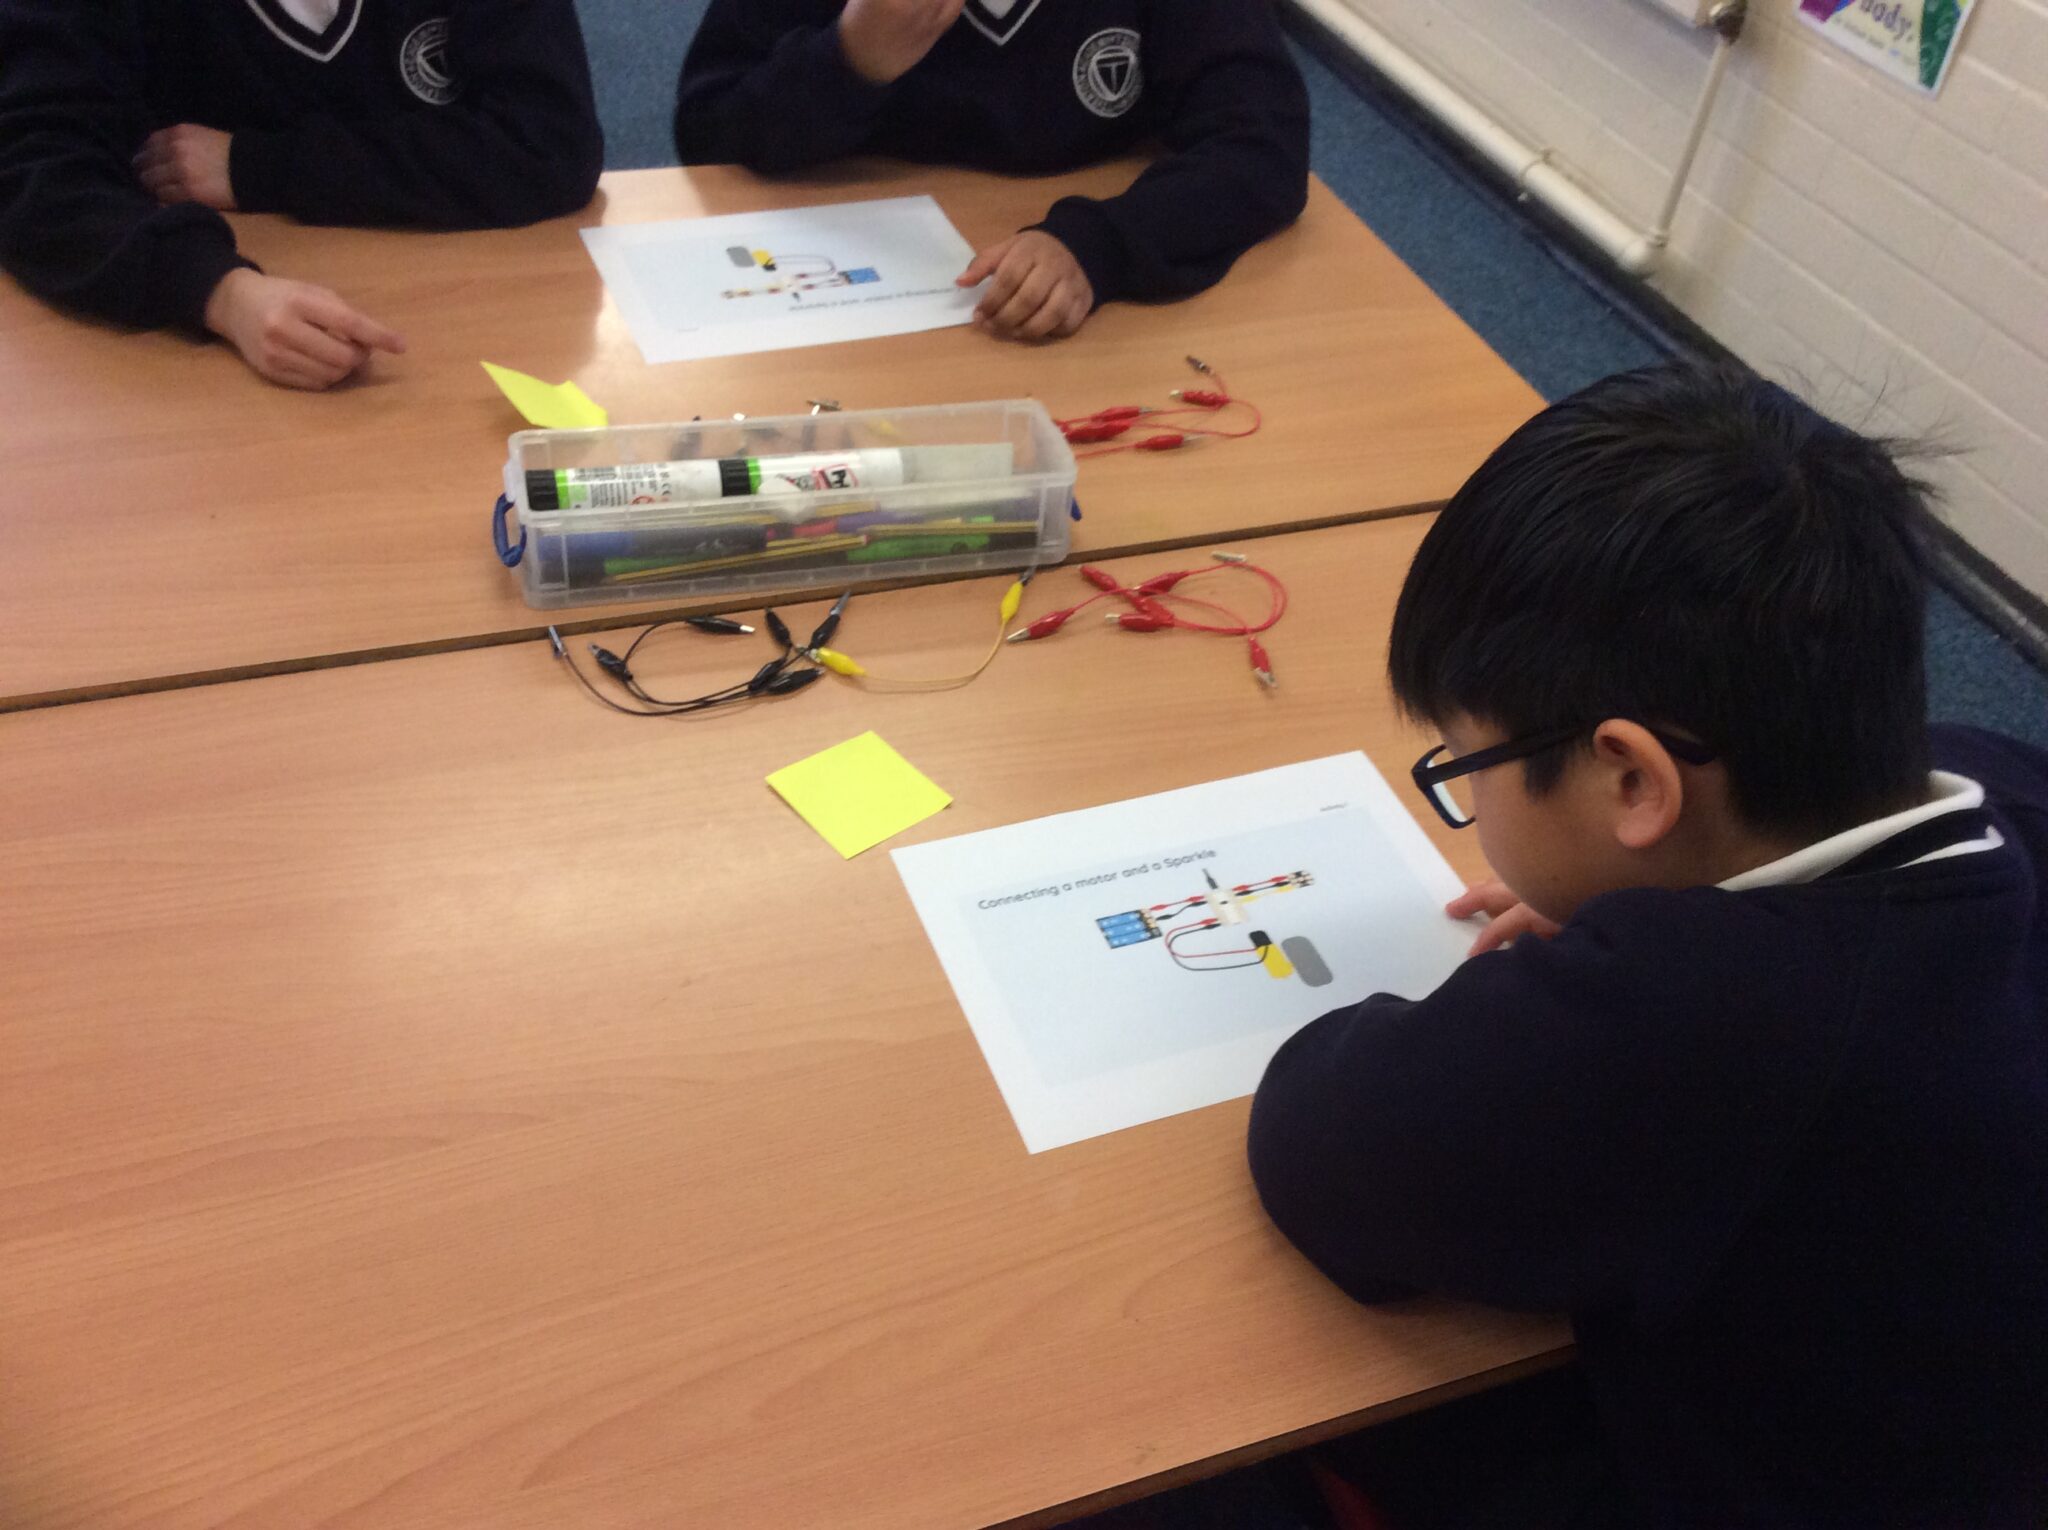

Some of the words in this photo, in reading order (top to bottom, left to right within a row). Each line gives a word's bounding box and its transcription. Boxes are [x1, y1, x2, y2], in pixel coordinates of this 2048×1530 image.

[977, 885, 1060, 909] Connecting
[1062, 883, 1072, 892] a
[1075, 872, 1117, 889] motor
[1121, 863, 1149, 878] and
[1151, 862, 1162, 871] a
[1163, 850, 1216, 868] Sparkle
